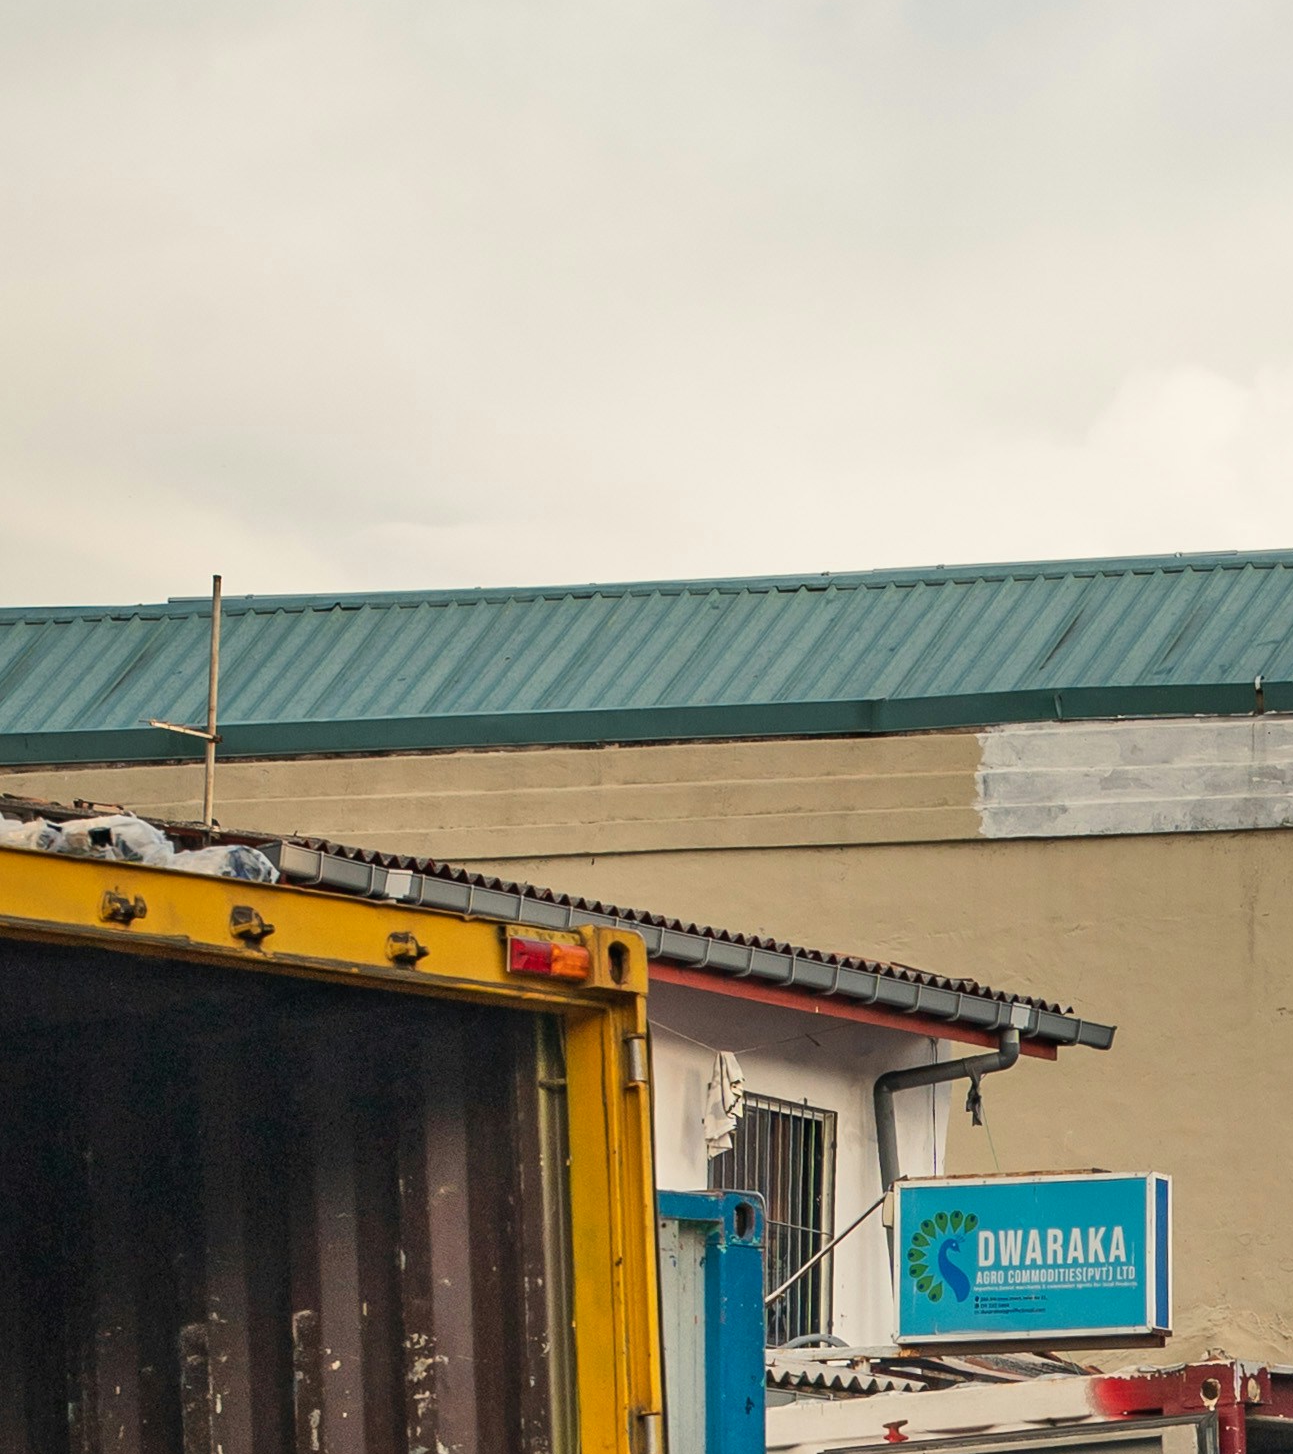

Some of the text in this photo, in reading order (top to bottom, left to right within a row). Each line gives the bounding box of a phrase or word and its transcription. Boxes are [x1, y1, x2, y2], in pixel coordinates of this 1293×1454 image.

[977, 1226, 1127, 1268] DWARAKA
[975, 1265, 1136, 1285] AGRO COMMODITIES(PVT) LTD
